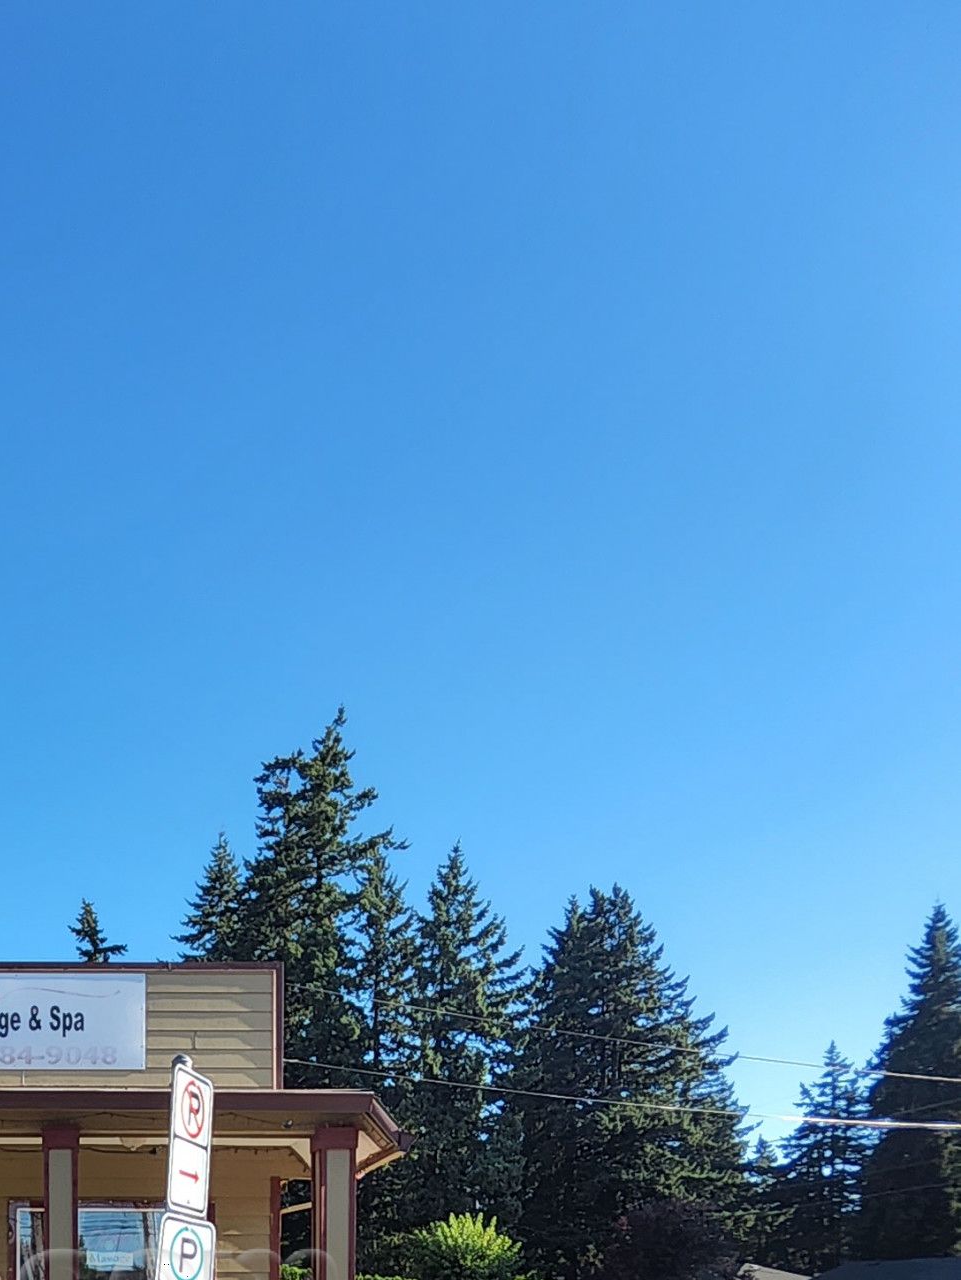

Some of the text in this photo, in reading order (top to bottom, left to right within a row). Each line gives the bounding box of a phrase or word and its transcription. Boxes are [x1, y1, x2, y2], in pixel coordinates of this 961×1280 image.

[28, 1005, 43, 1032] &
[49, 1005, 85, 1038] Spa
[179, 1237, 198, 1273] P
